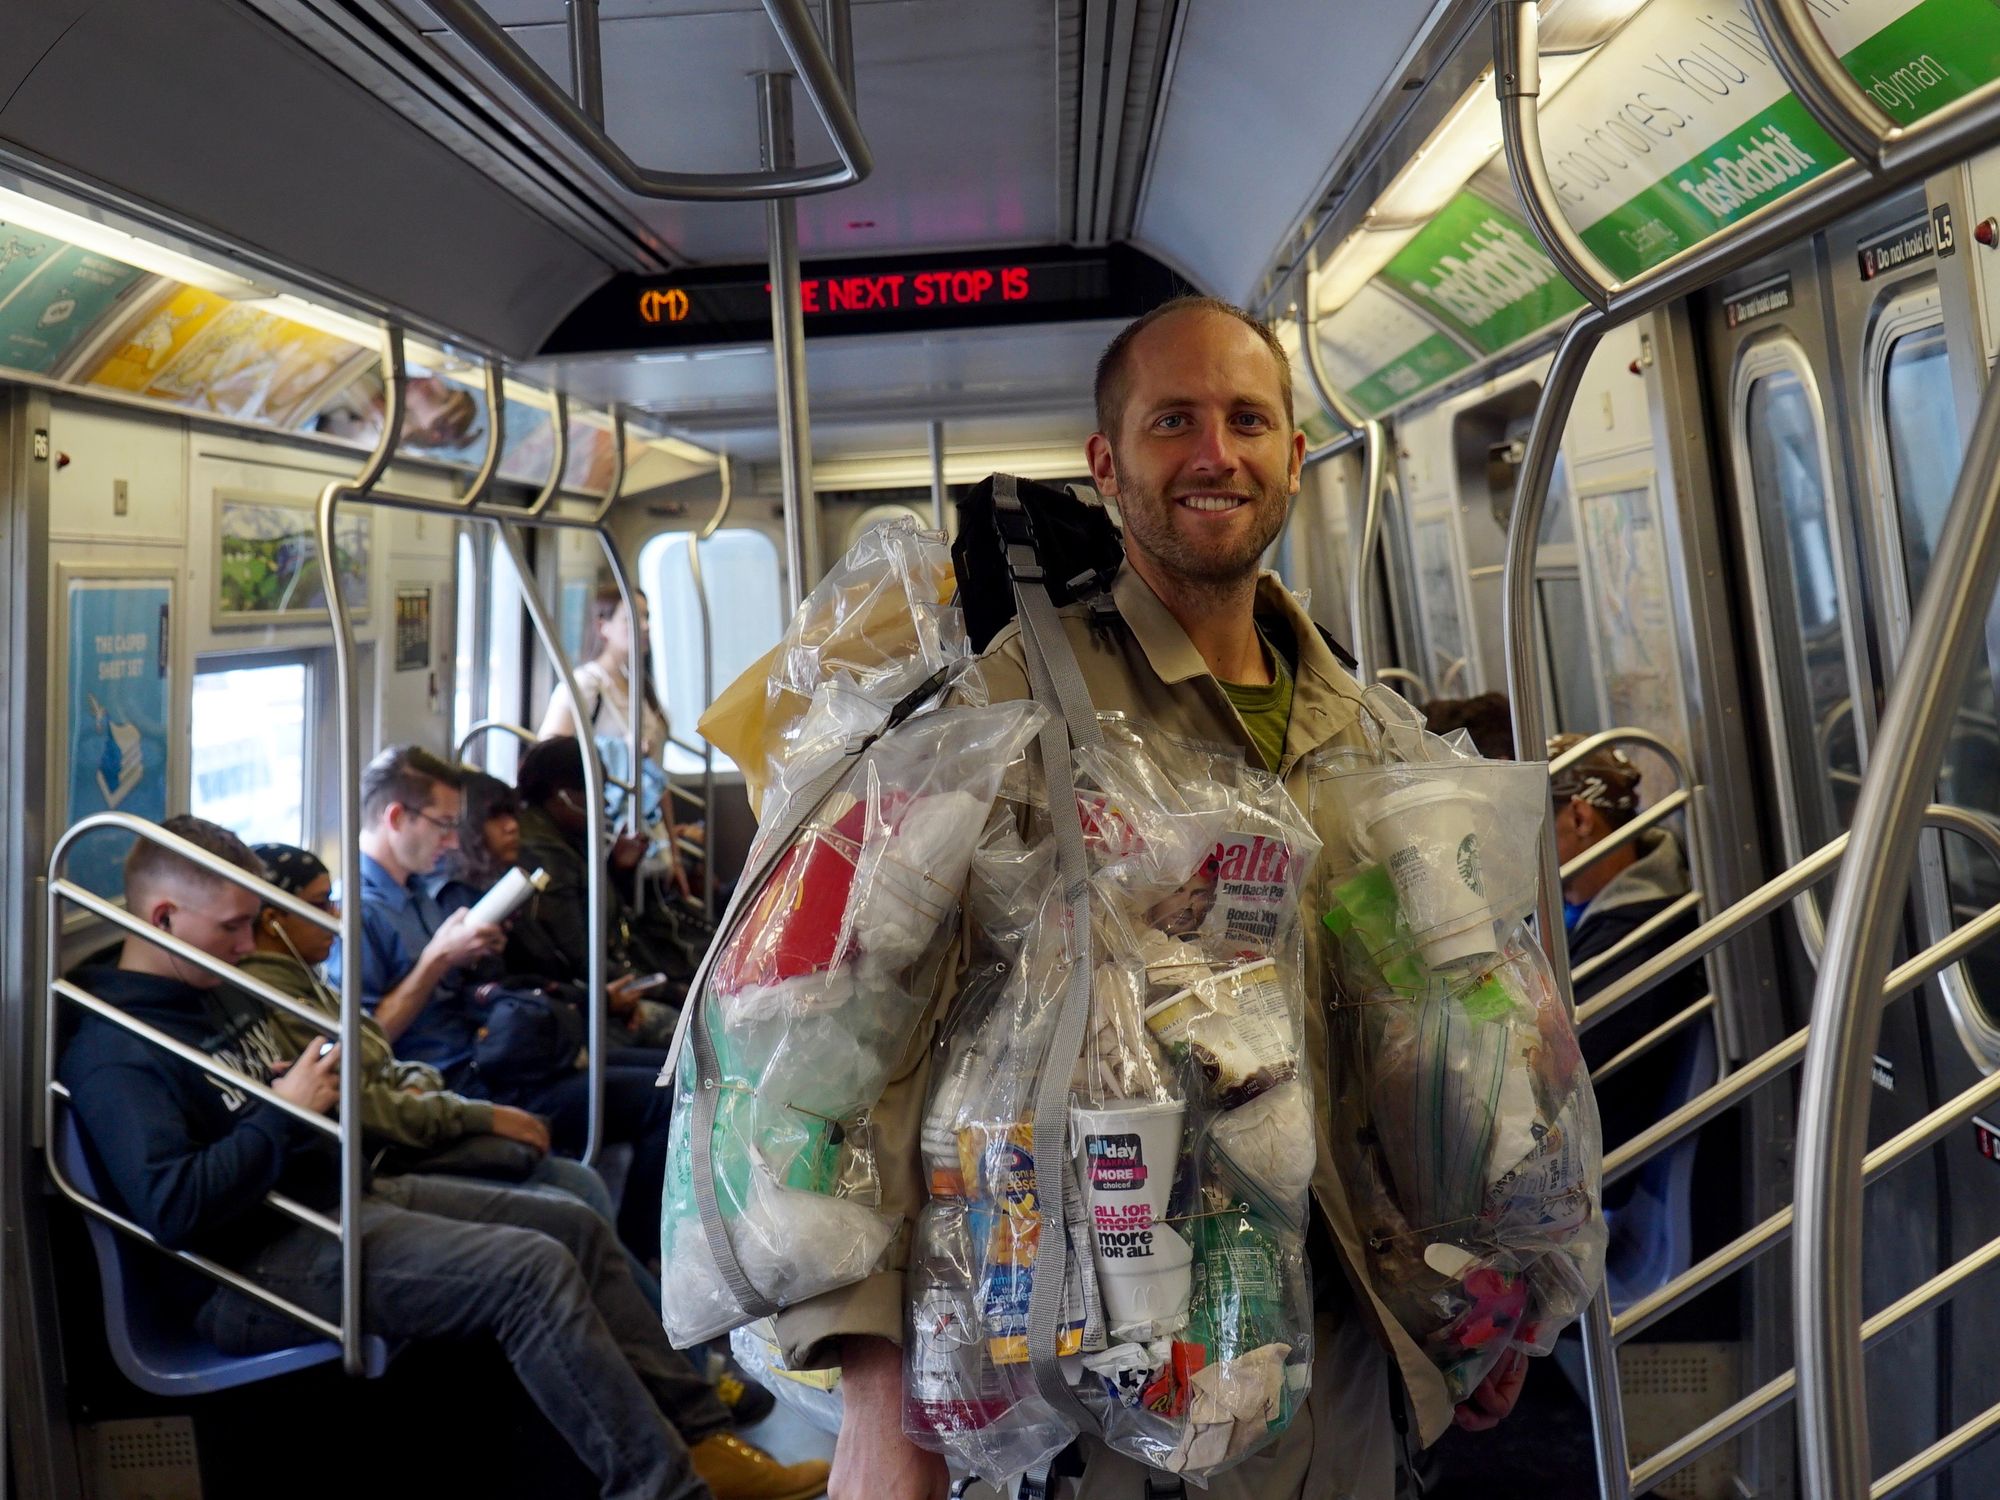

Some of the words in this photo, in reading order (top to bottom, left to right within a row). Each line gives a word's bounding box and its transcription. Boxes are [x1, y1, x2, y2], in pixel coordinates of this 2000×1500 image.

[1642, 43, 1750, 104] You
[1865, 54, 1949, 110] ndyman
[1679, 124, 1816, 218] TaskRabbit
[1877, 247, 1890, 270] Do
[1889, 243, 1904, 265] not
[1904, 230, 1924, 258] hold
[1935, 215, 1953, 250] L5
[828, 276, 904, 312] NEXT
[913, 271, 993, 306] STOP
[1001, 268, 1030, 300] IS
[1105, 1142, 1138, 1160] day
[1098, 1168, 1134, 1180] MORE
[1096, 1215, 1153, 1232] more
[1098, 1230, 1153, 1247] more
